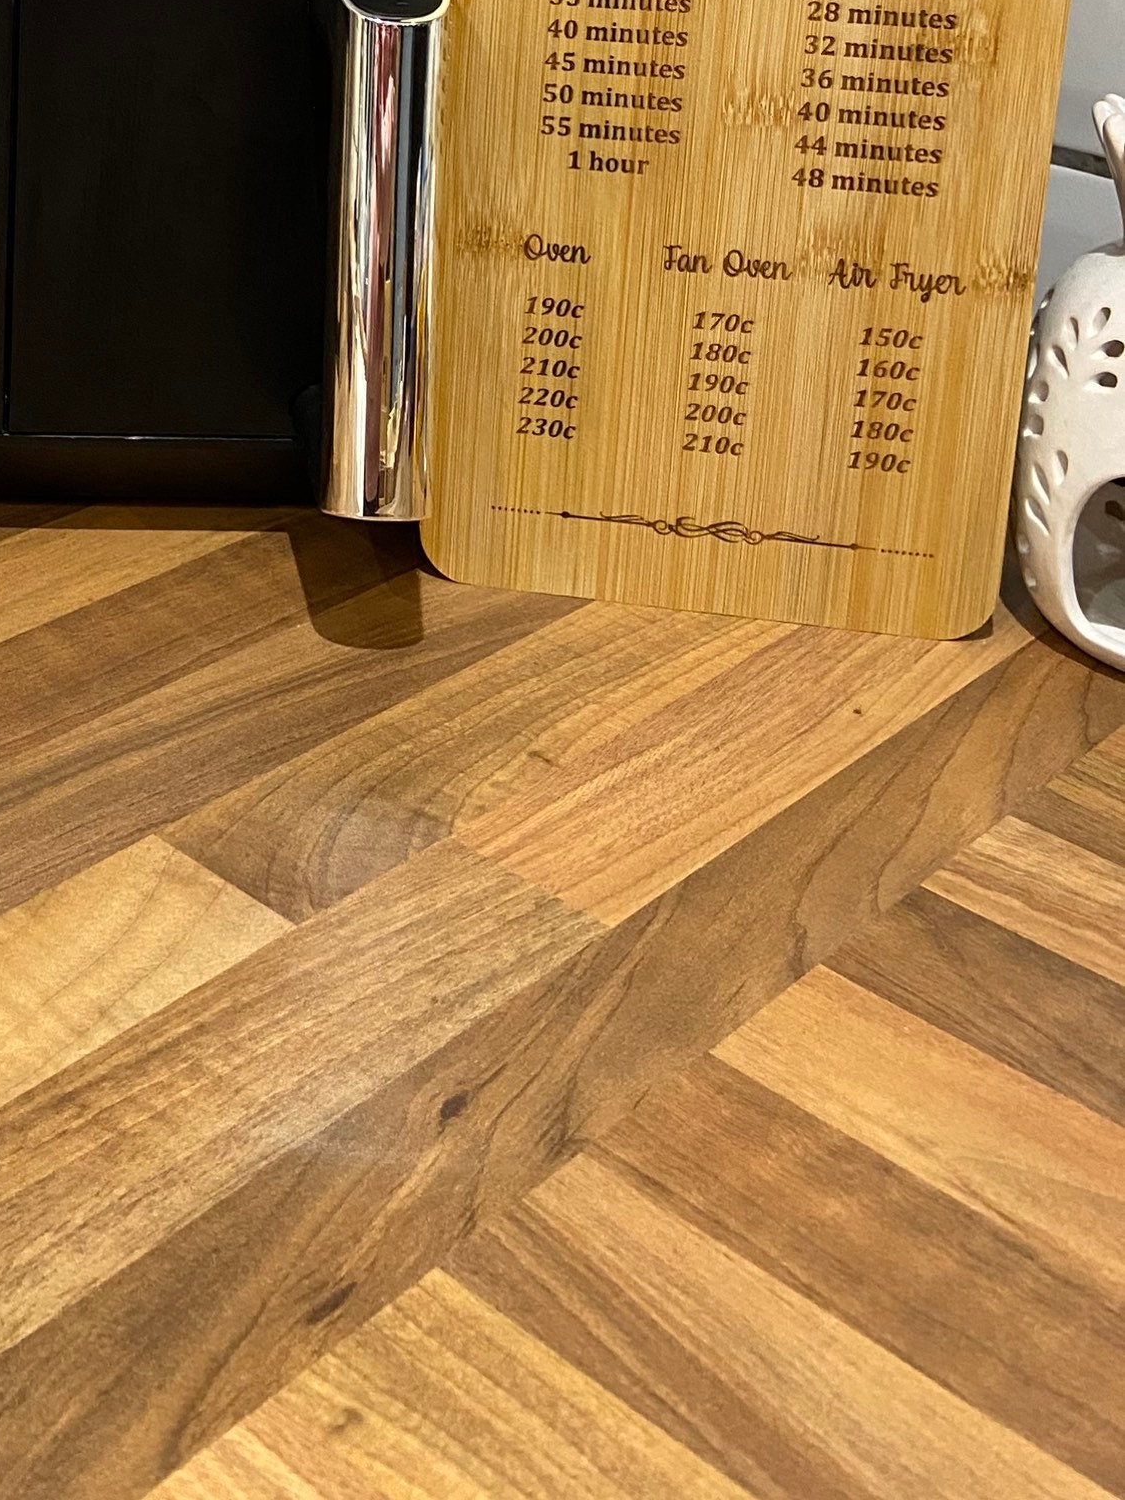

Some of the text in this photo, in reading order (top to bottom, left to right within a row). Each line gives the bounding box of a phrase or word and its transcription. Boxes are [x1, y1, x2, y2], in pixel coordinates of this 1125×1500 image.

[807, 2, 957, 30] 28 minutes
[547, 20, 688, 47] 40 minutes
[545, 52, 685, 80] 45 minutes
[801, 68, 950, 98] 36 minutes
[543, 84, 683, 112] 50 minutes
[541, 116, 680, 144] 55 minutes
[798, 102, 946, 131] 40 minutes
[568, 151, 650, 175] 1 hour
[795, 135, 943, 165] 44 minutes
[792, 168, 939, 198] 48 minutes
[524, 234, 591, 266] Oven
[663, 245, 793, 281] Fan Oven
[827, 258, 967, 303] Air Fryer
